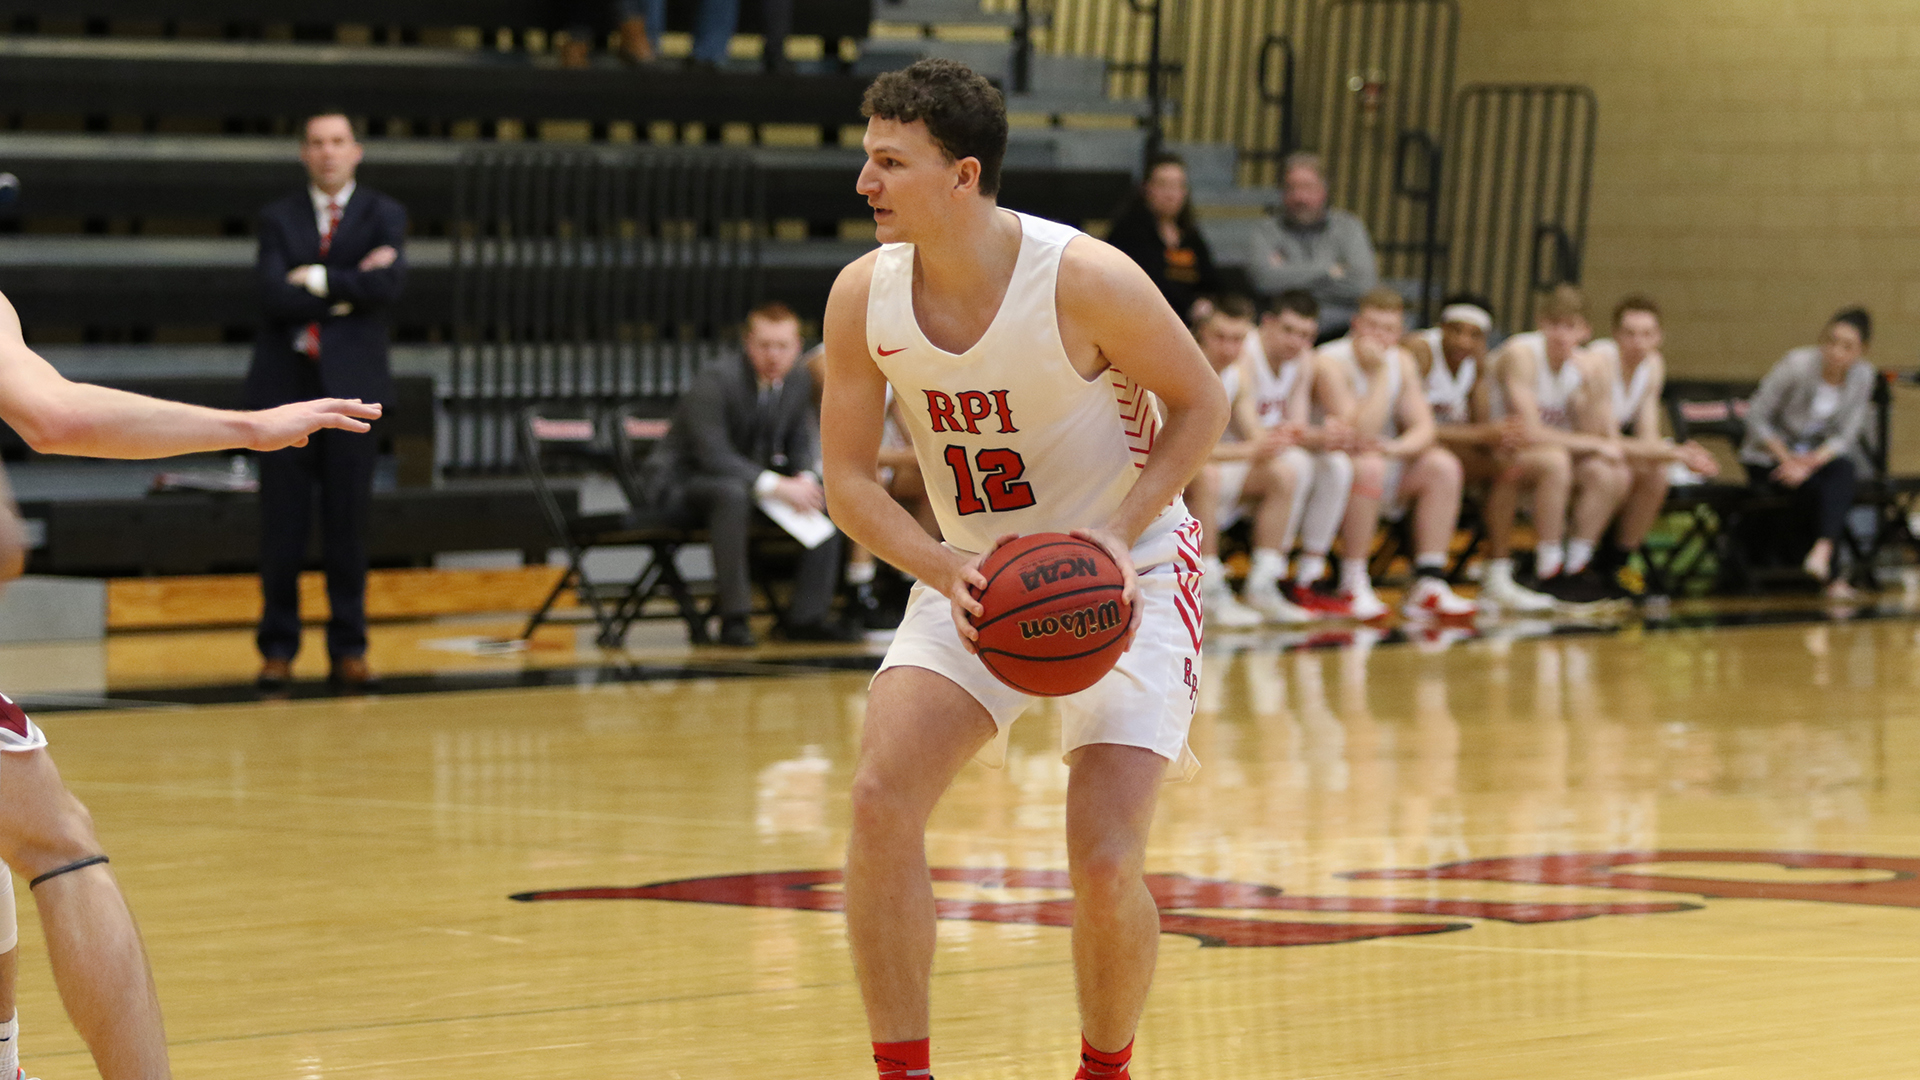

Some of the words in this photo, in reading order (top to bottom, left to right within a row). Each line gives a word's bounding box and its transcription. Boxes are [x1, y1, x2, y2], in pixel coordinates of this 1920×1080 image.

[921, 388, 1020, 435] RPI
[943, 444, 1037, 516] 12
[1019, 557, 1098, 592] NCAA
[1018, 599, 1122, 640] Wilson
